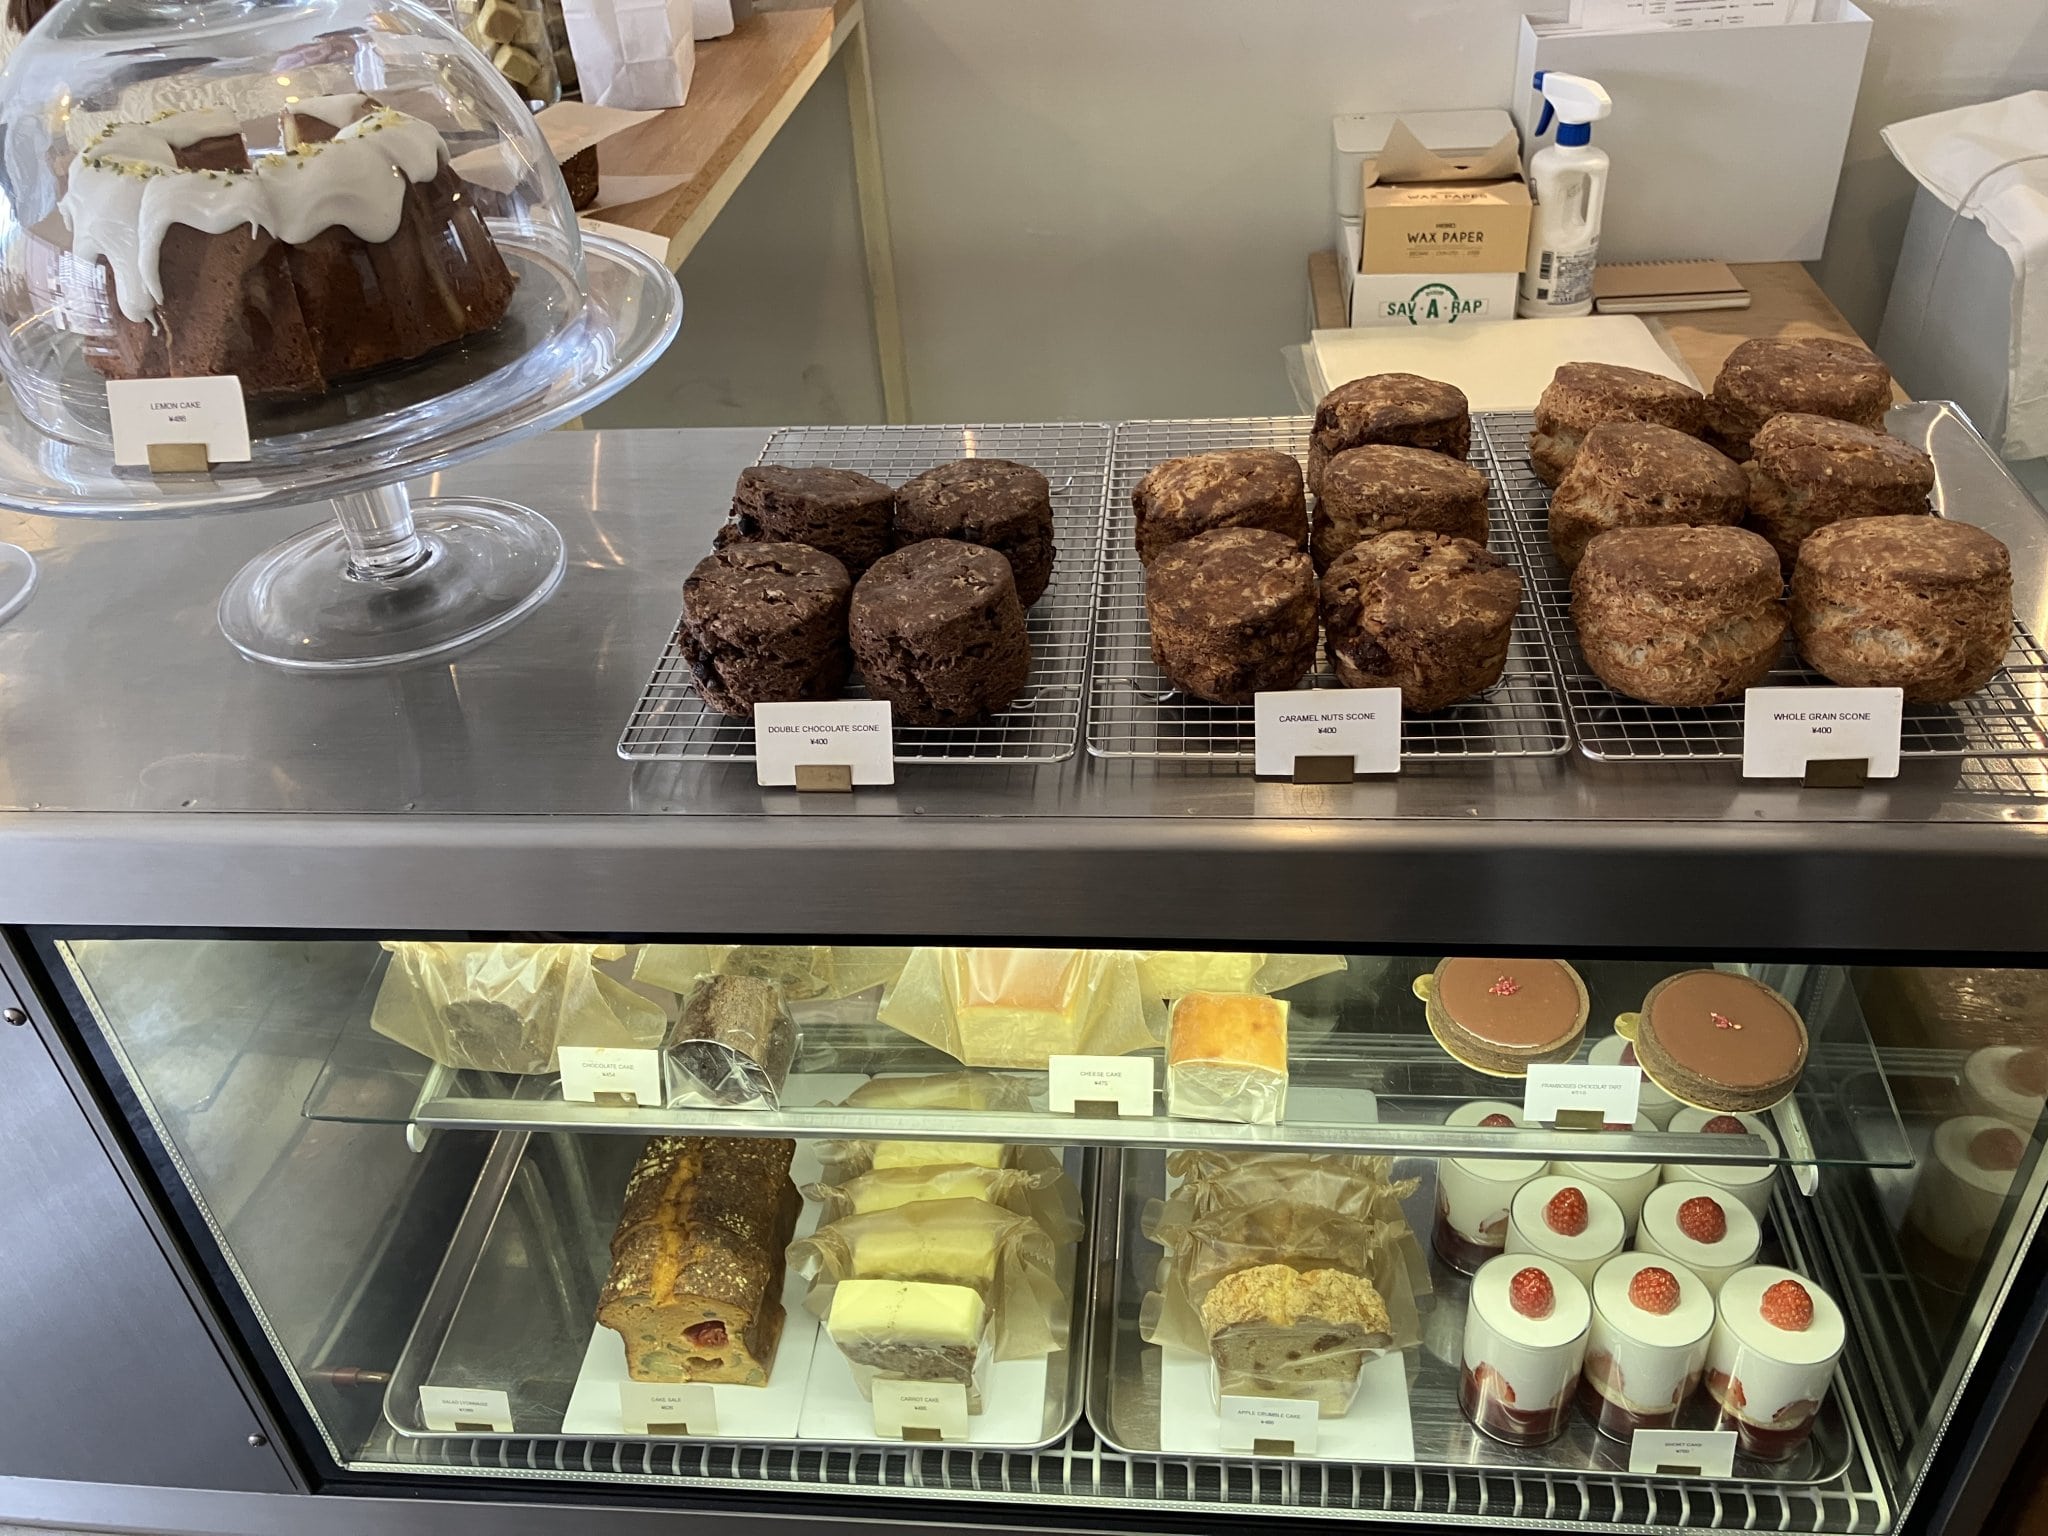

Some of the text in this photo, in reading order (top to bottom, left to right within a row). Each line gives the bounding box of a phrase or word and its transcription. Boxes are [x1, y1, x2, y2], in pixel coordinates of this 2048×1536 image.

[1407, 231, 1484, 243] WAX PAPER
[1387, 298, 1482, 318] SAV A RAP
[150, 401, 201, 410] LEMON CAKE
[1278, 712, 1376, 723] CARAMEL NUTS SCONE
[1773, 713, 1871, 721] WHOLE GRAIN SCONE
[802, 725, 850, 733] CHOCOLATE
[852, 724, 880, 732] SCONE
[1812, 726, 1832, 734] ¥400
